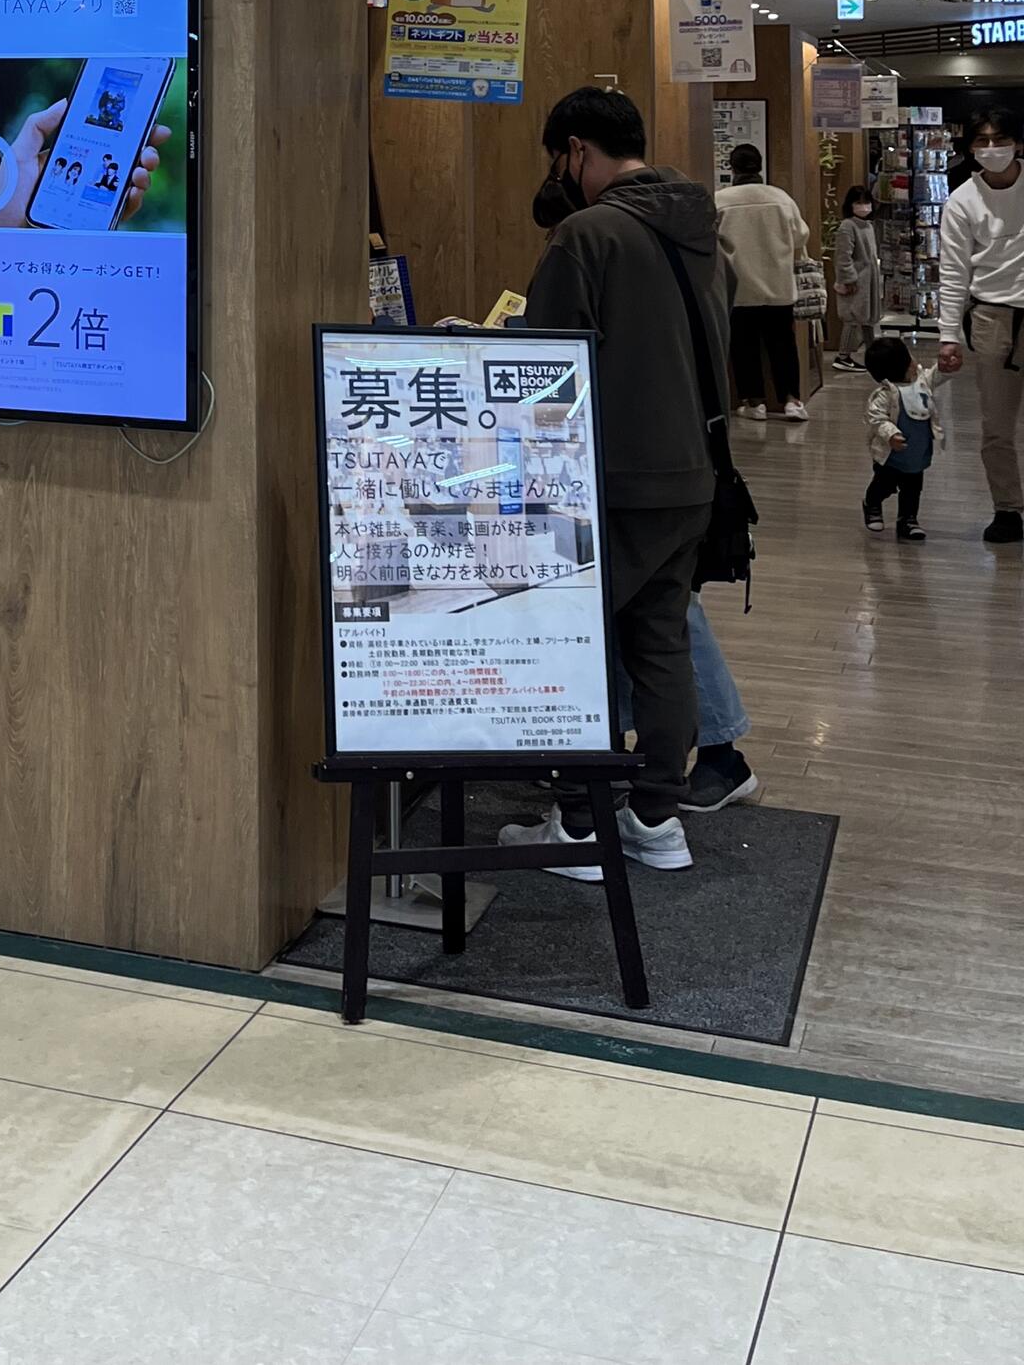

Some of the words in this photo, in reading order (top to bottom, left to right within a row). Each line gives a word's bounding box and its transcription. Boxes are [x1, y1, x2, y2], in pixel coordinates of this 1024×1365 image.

[28, 287, 109, 352] 2倍
[519, 365, 568, 376] TSUTAYA
[493, 369, 516, 393] 本
[521, 377, 553, 387] BOOK
[340, 366, 497, 430] 募集。
[331, 452, 447, 471] TSUTAYAで
[333, 479, 584, 500] 一緒に働いてみませんか？
[334, 520, 548, 537] 本や雑誌、音楽、映画が好き！
[336, 542, 488, 560] 人と接するのが好き！
[490, 716, 527, 725] TSUTAYA
[532, 715, 555, 724] BOOK
[557, 714, 582, 723] STORE
